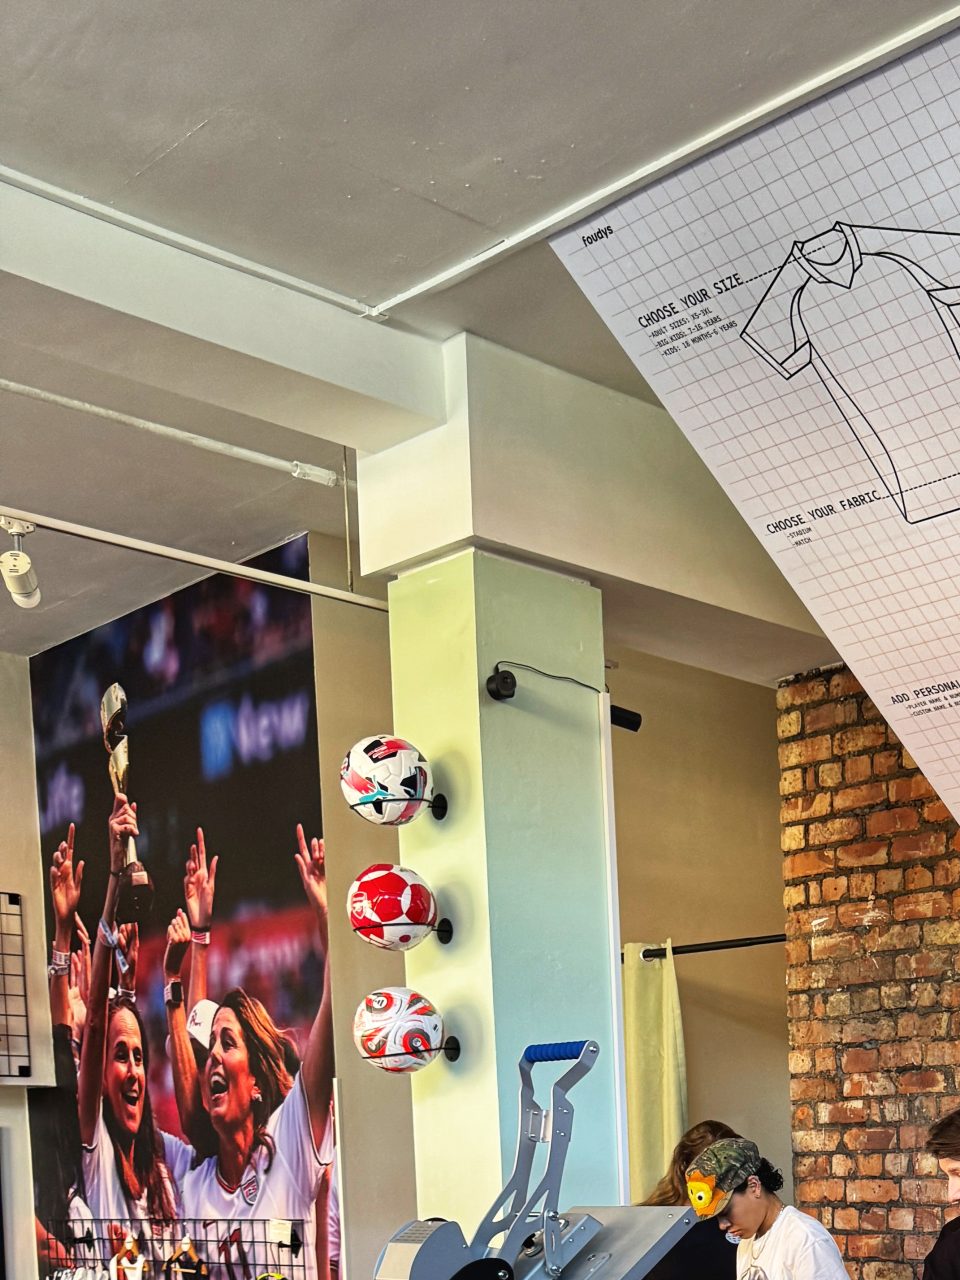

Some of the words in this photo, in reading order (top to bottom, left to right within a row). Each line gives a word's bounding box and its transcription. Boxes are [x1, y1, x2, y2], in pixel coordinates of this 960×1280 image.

[582, 225, 614, 247] foudys
[638, 302, 679, 328] CHOOSE
[680, 288, 712, 309] YOUR
[713, 273, 744, 294] SIZE
[704, 316, 722, 327] YEARS
[719, 320, 738, 332] YEARS
[766, 514, 806, 534] CHOOSE
[807, 504, 837, 520] YOUR
[840, 490, 882, 510] FABRIC
[890, 693, 910, 704] ADD
